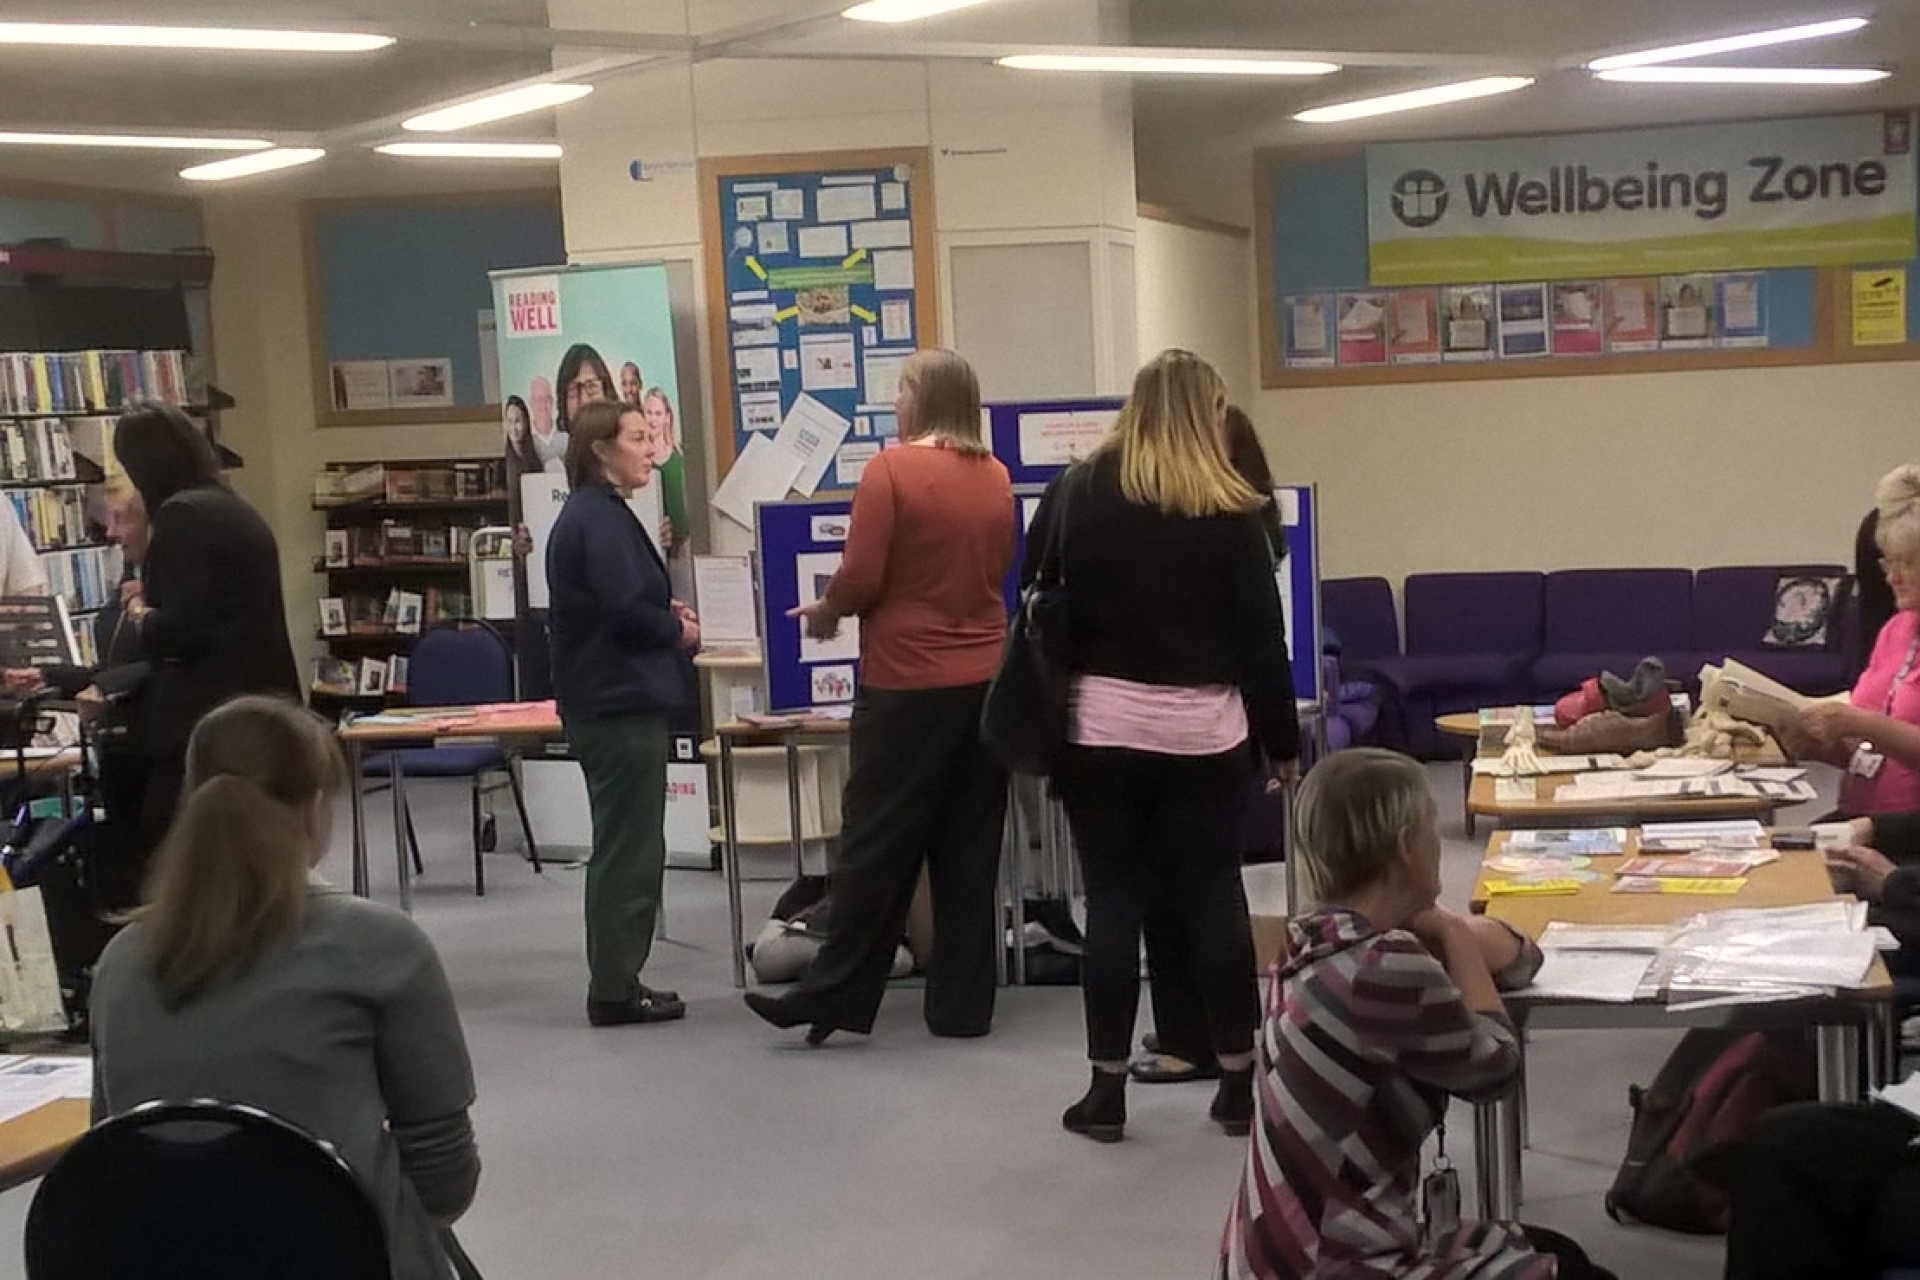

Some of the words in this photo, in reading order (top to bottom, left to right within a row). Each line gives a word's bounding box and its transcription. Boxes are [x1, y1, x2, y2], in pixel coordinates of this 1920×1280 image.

[1464, 161, 1728, 219] Wellbeing
[1748, 156, 1887, 202] Zone
[509, 291, 556, 307] READING
[510, 306, 558, 332] WELL
